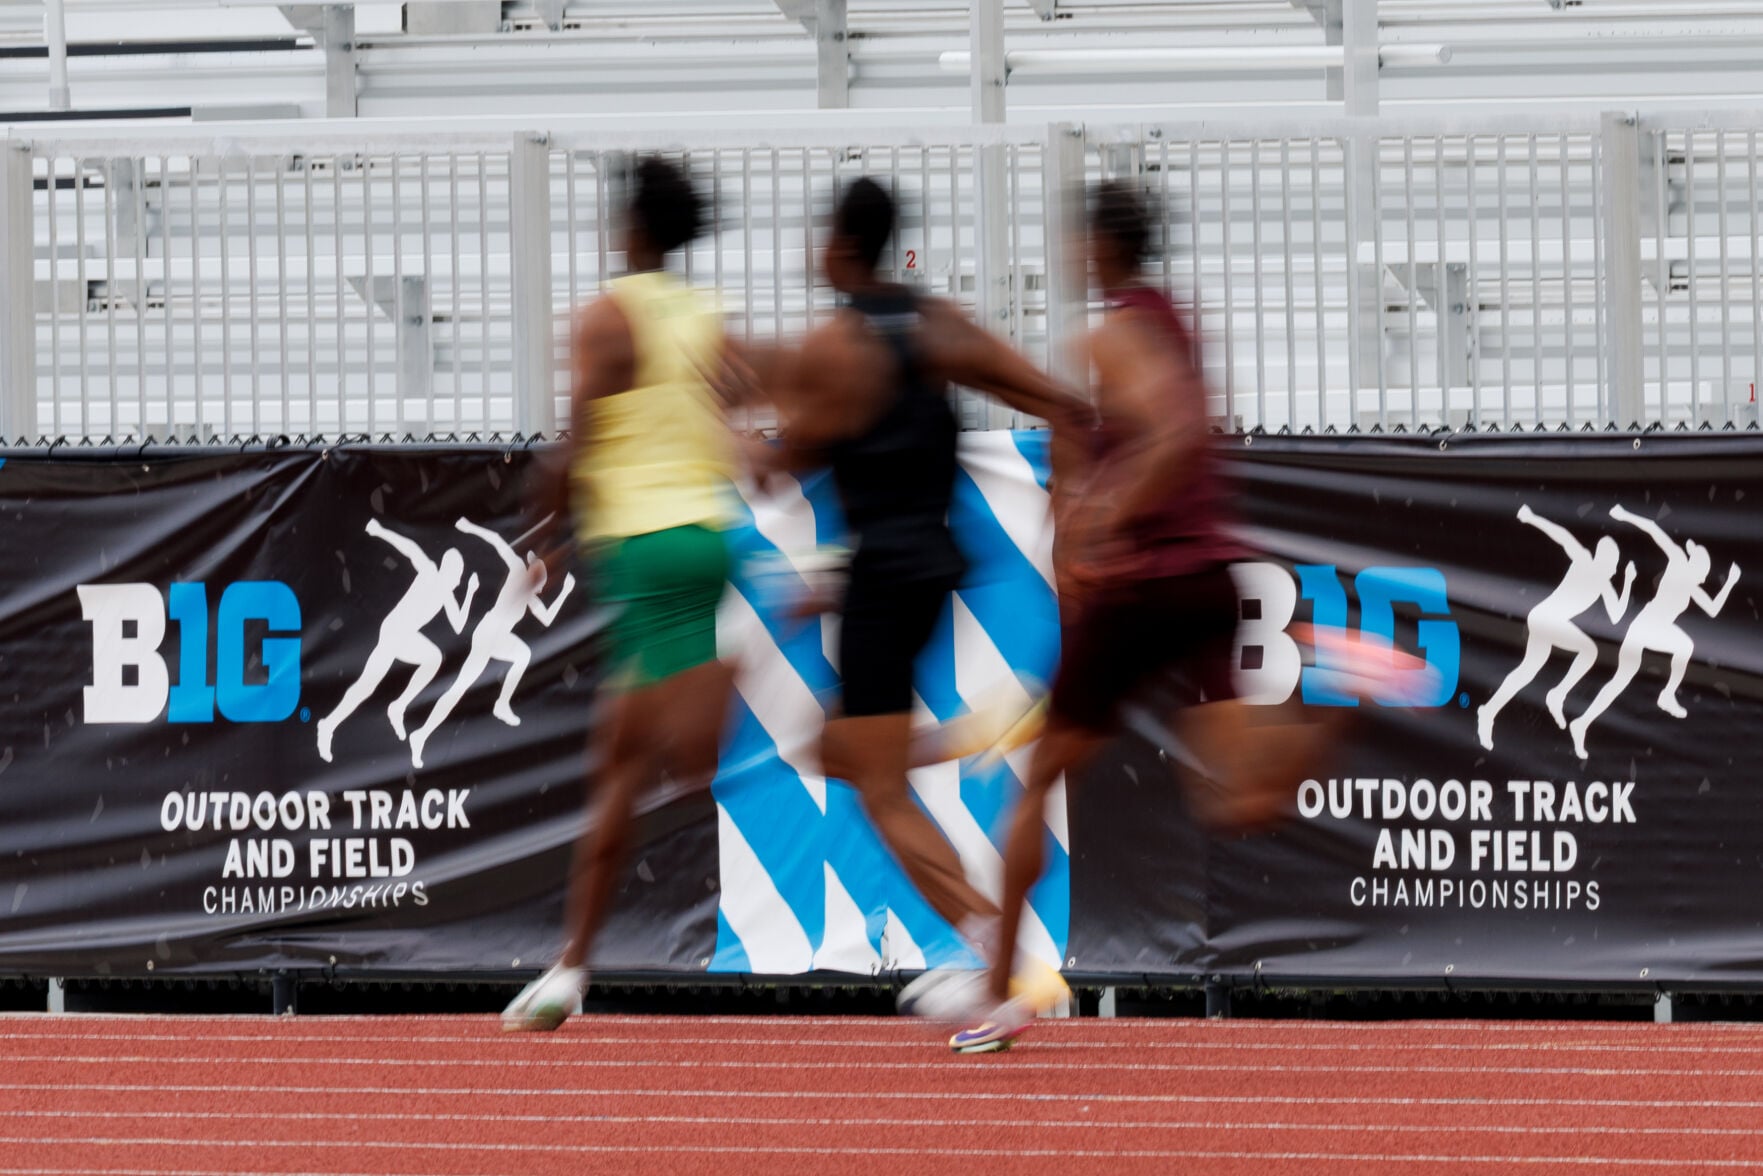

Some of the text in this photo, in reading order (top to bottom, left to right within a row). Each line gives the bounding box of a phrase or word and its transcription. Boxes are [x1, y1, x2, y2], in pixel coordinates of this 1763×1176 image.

[906, 249, 916, 269] 2
[1749, 383, 1756, 403] 1
[160, 789, 471, 831] OUTDOOR TRACK
[1297, 778, 1637, 823] OUTDOOR TRACK
[222, 838, 415, 878] AND FIELD
[1372, 828, 1578, 872] AND FIELD
[203, 880, 429, 914] CHAMPIONSHIPS
[1350, 876, 1601, 911] CHAMPIONSHIPS
